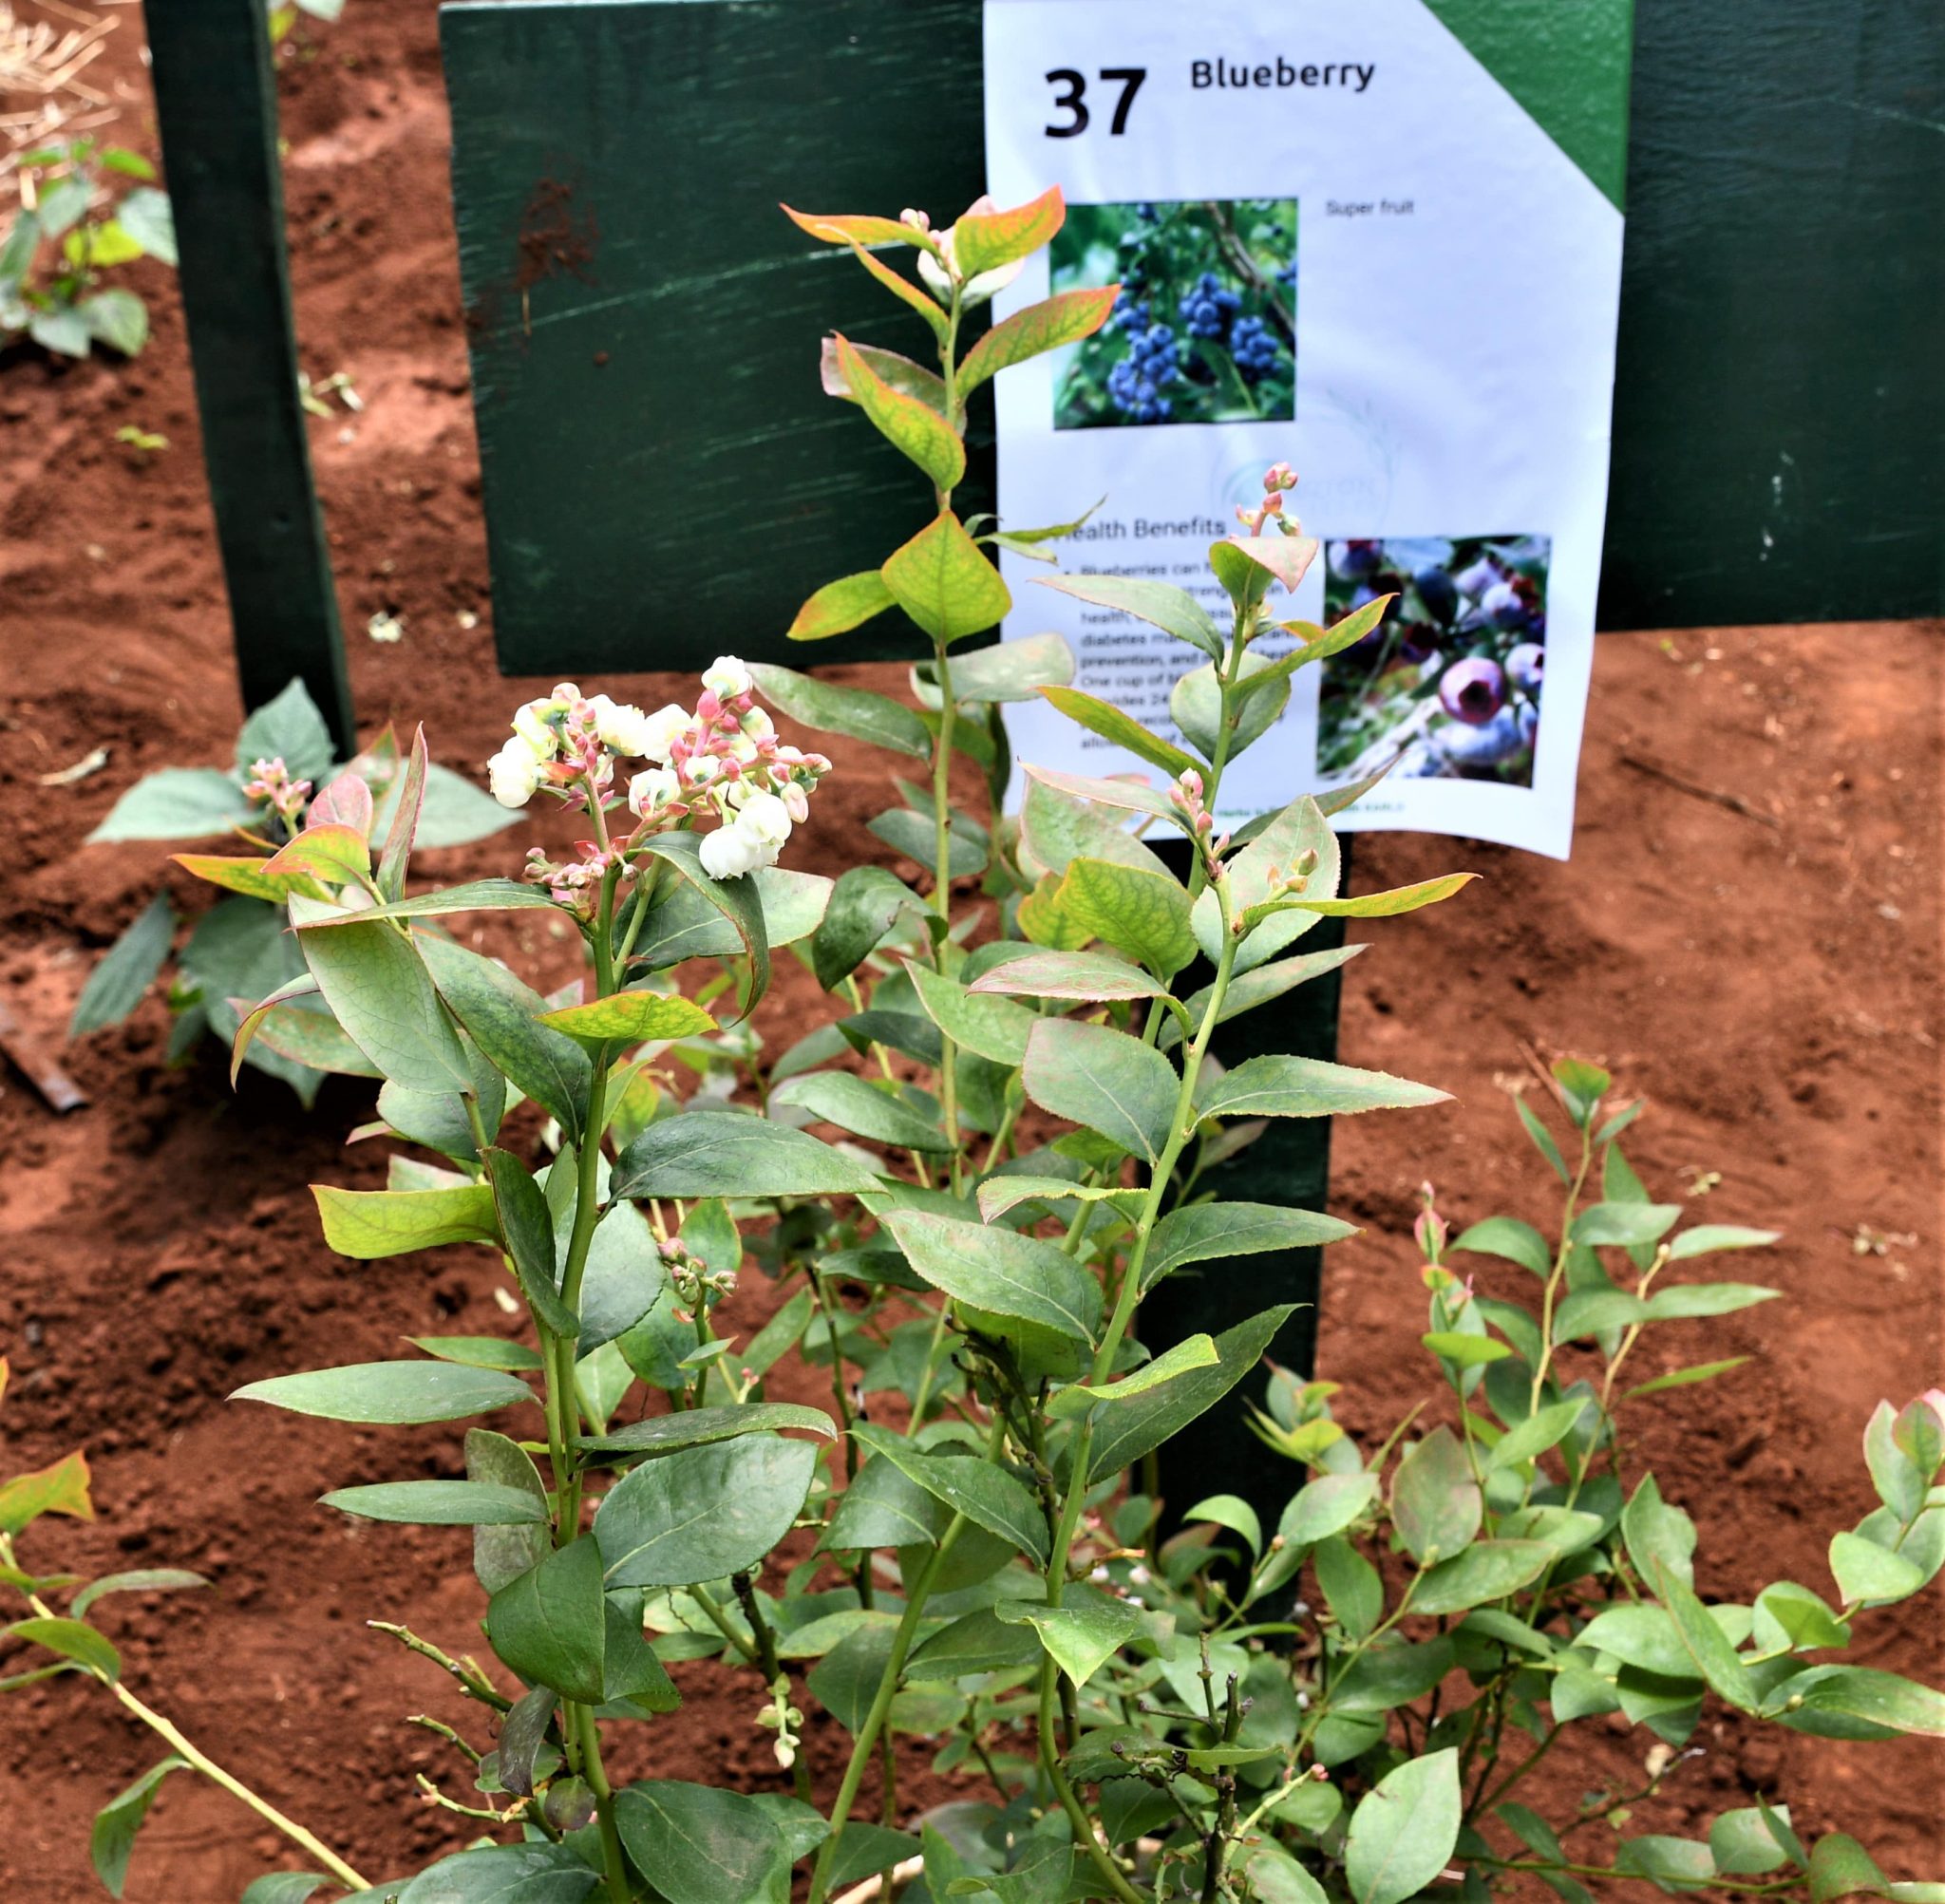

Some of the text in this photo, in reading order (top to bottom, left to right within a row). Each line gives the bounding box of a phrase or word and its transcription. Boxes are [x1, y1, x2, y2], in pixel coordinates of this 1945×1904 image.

[1045, 57, 1375, 138] 37 Blueberry
[1326, 198, 1414, 218] Super fruit
[1053, 516, 1227, 542] ealth Benefits
[1081, 633, 1146, 647] diabetes
